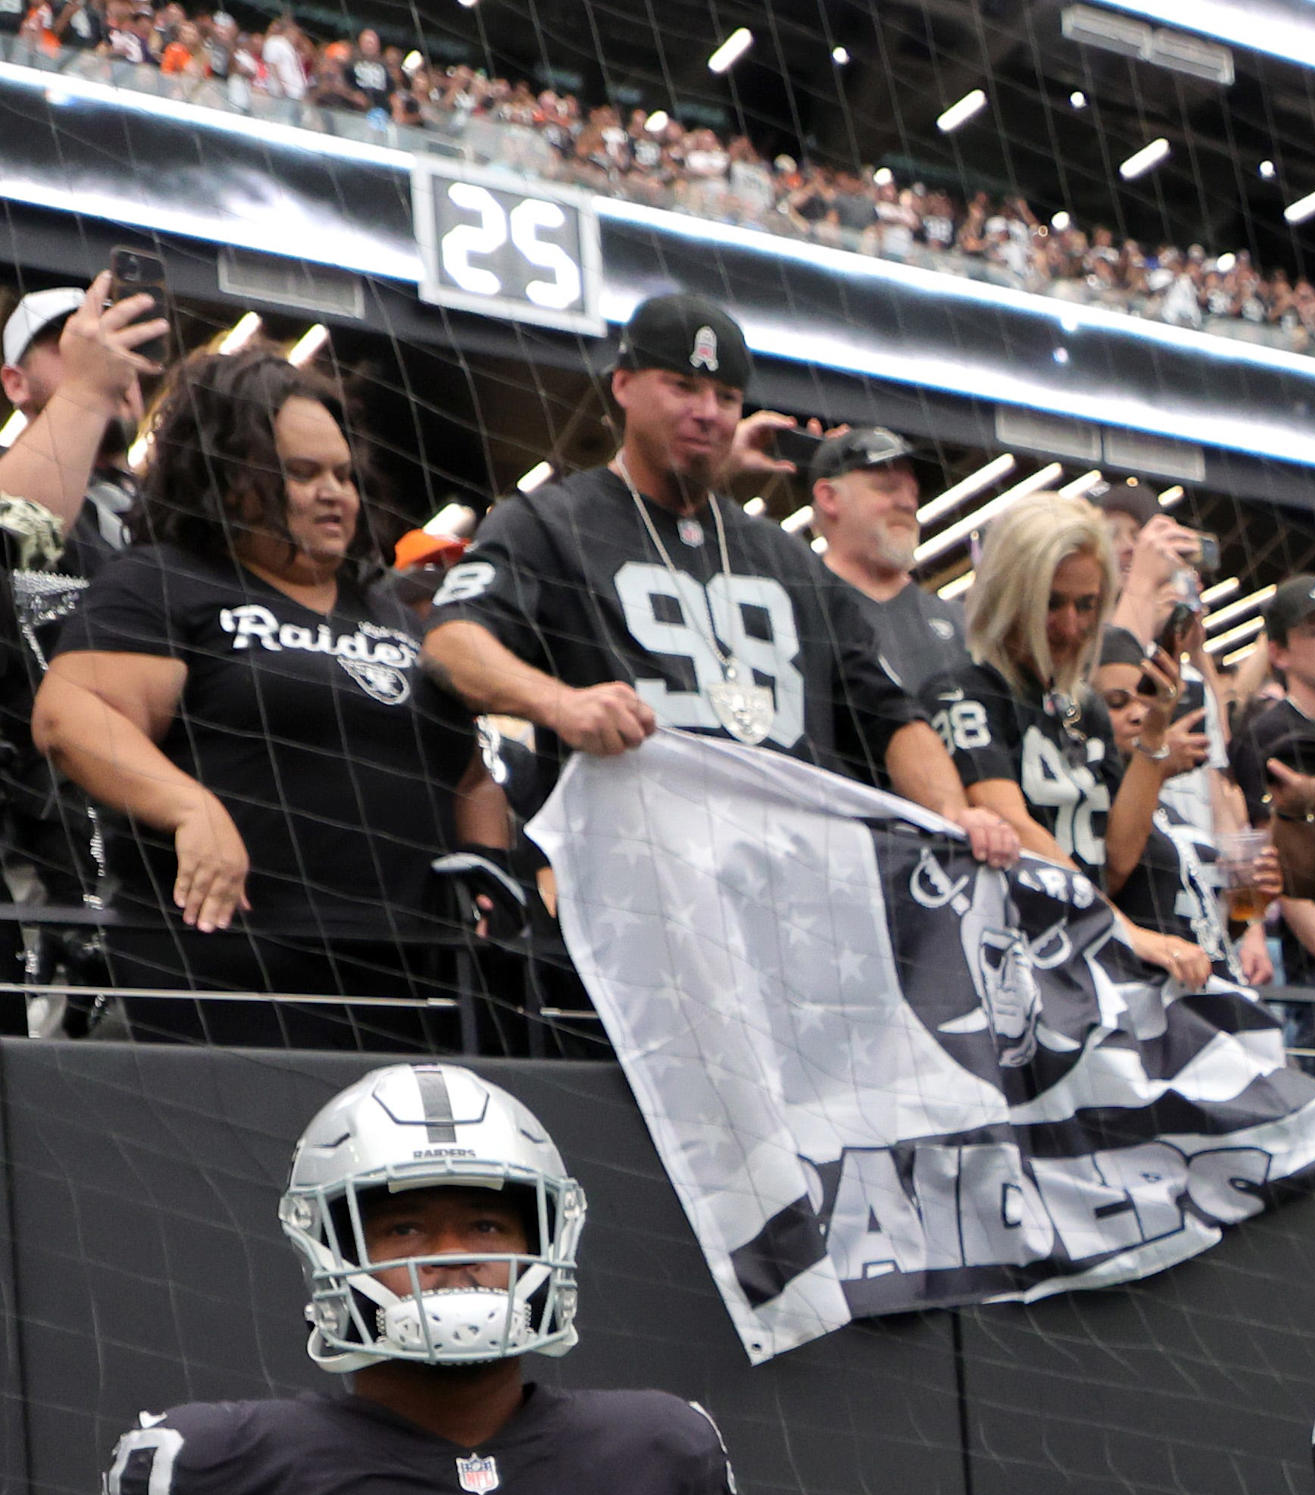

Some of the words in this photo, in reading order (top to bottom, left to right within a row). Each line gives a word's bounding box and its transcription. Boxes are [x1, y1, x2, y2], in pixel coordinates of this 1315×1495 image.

[441, 182, 581, 311] 25
[614, 561, 804, 748] 98
[799, 1140, 1271, 1281] AIDERS
